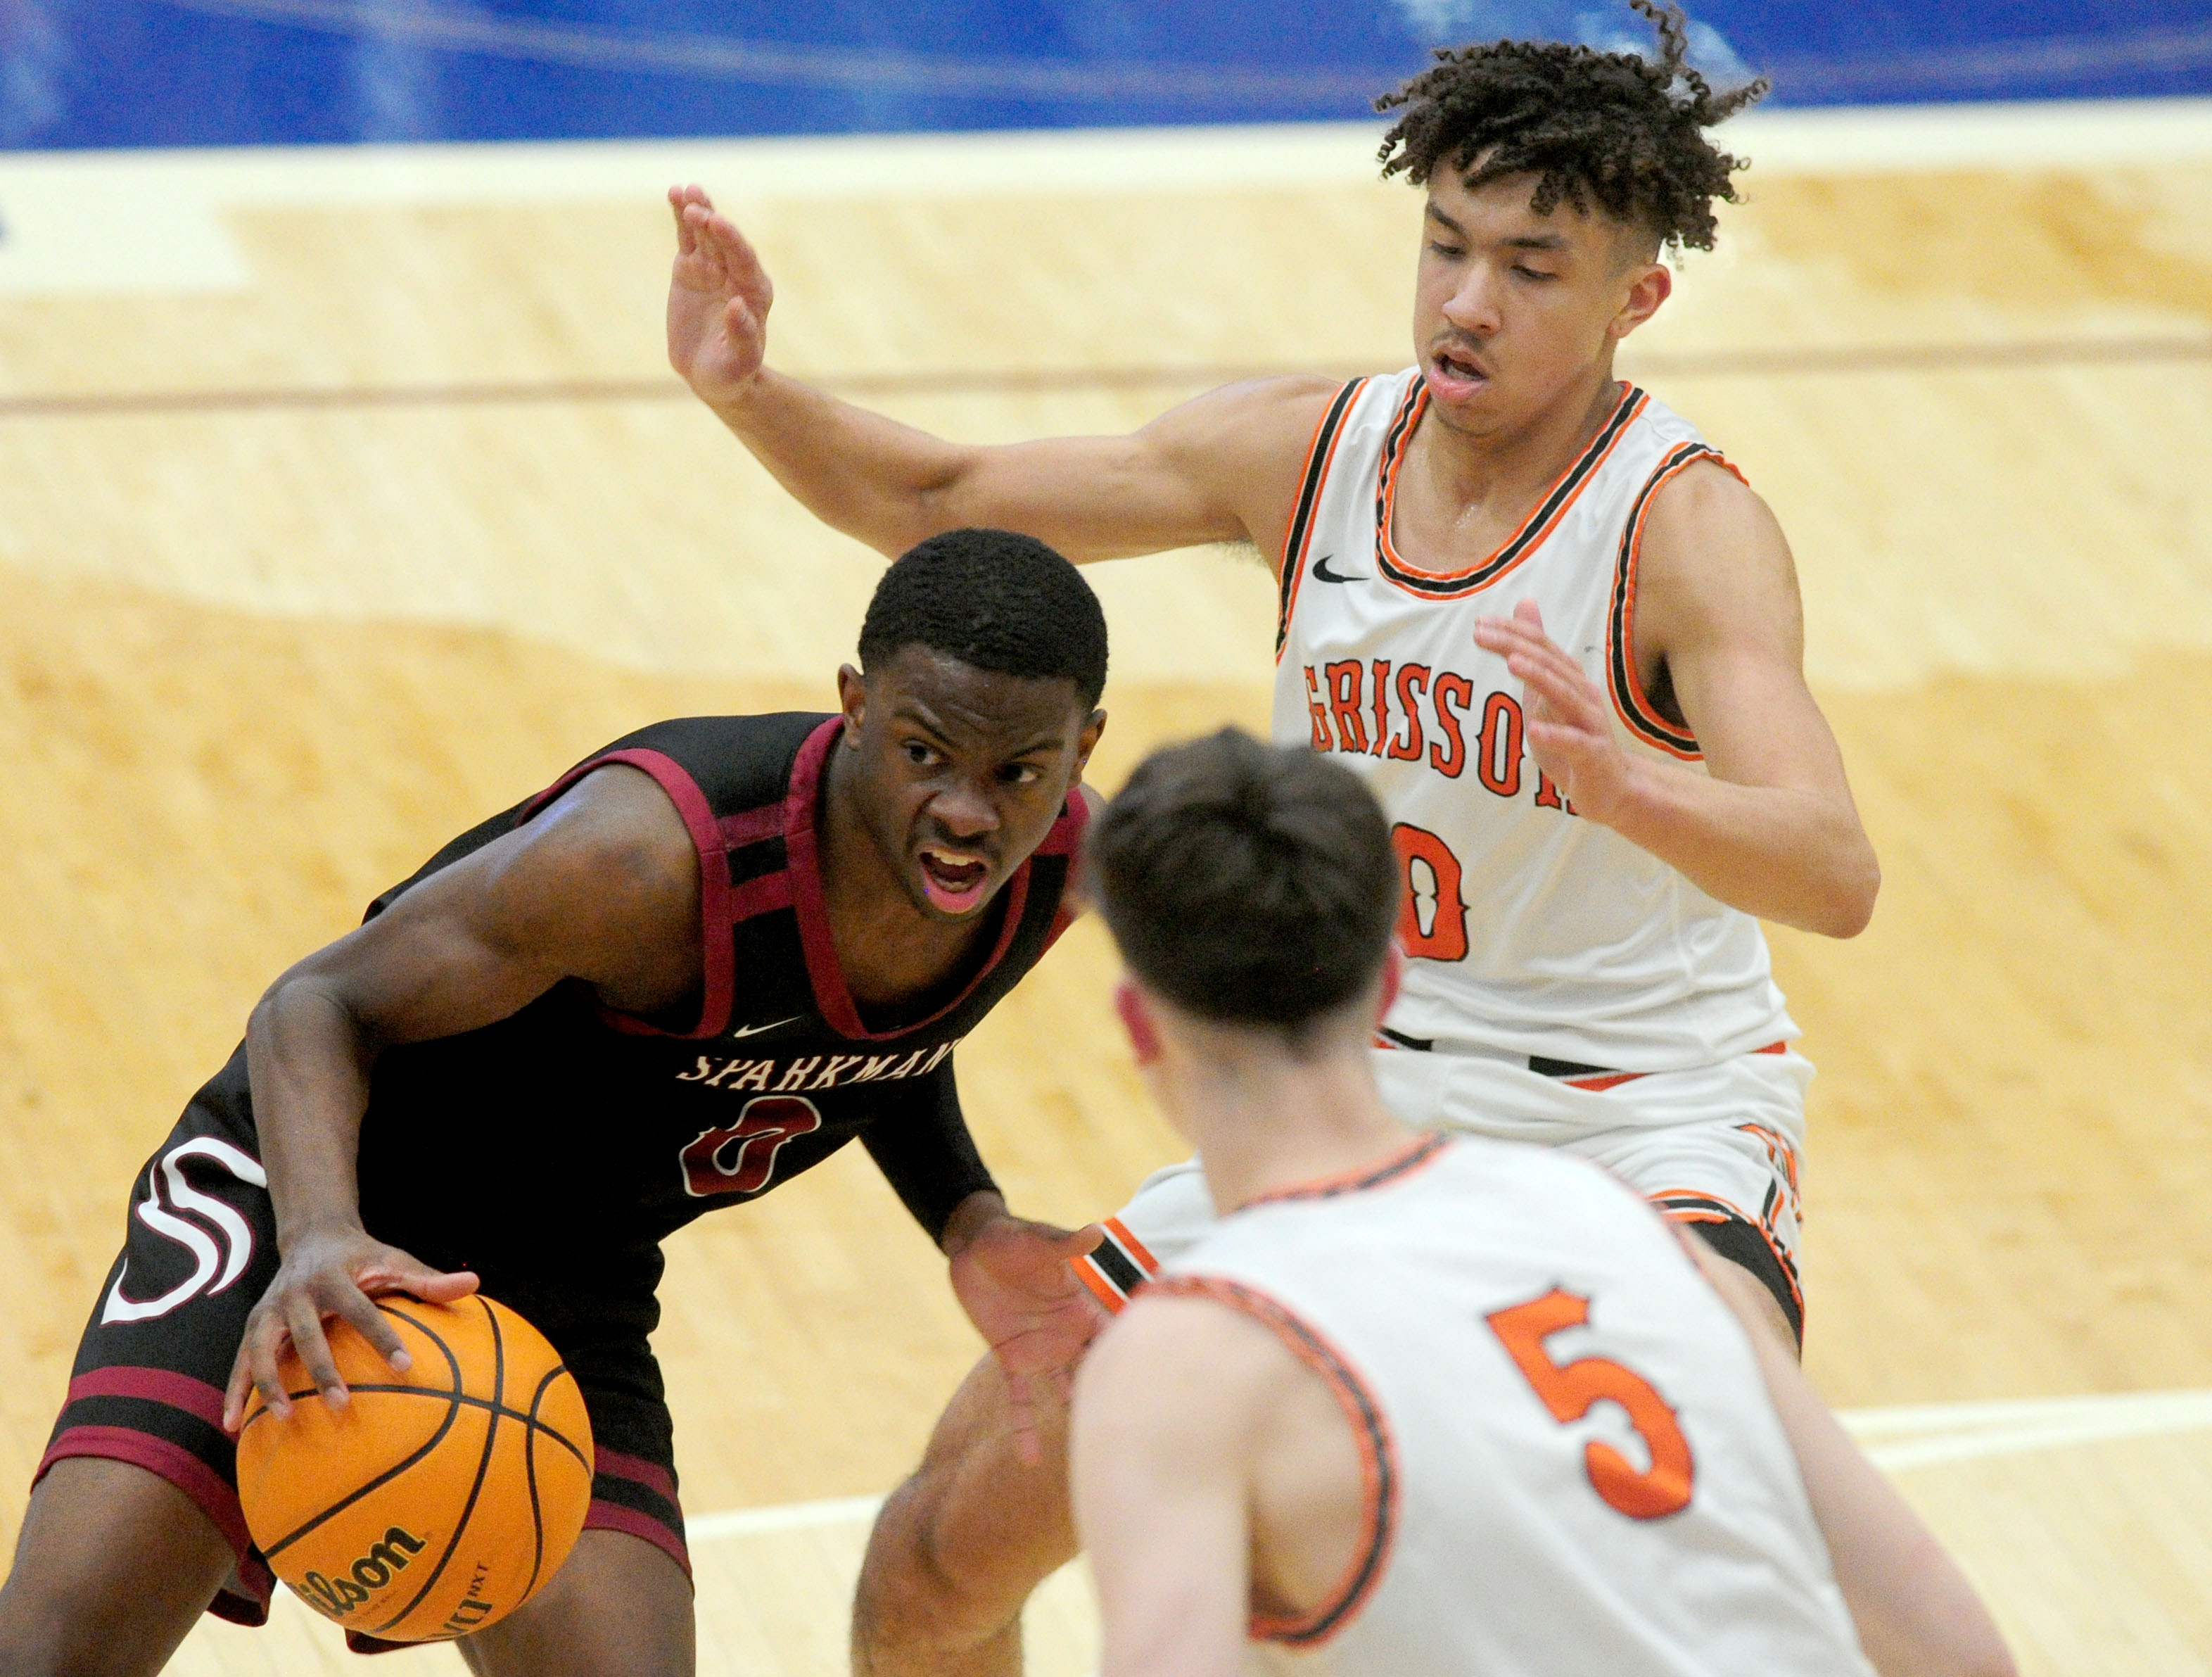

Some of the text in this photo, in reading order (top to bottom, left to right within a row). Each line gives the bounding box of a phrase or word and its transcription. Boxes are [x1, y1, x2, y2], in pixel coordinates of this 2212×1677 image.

[675, 1037, 963, 1091] SPARKMAN
[678, 1095, 822, 1197] 0
[1480, 1282, 1696, 1521] 5
[284, 1526, 428, 1617] ilson
[466, 1561, 489, 1597] NXT
